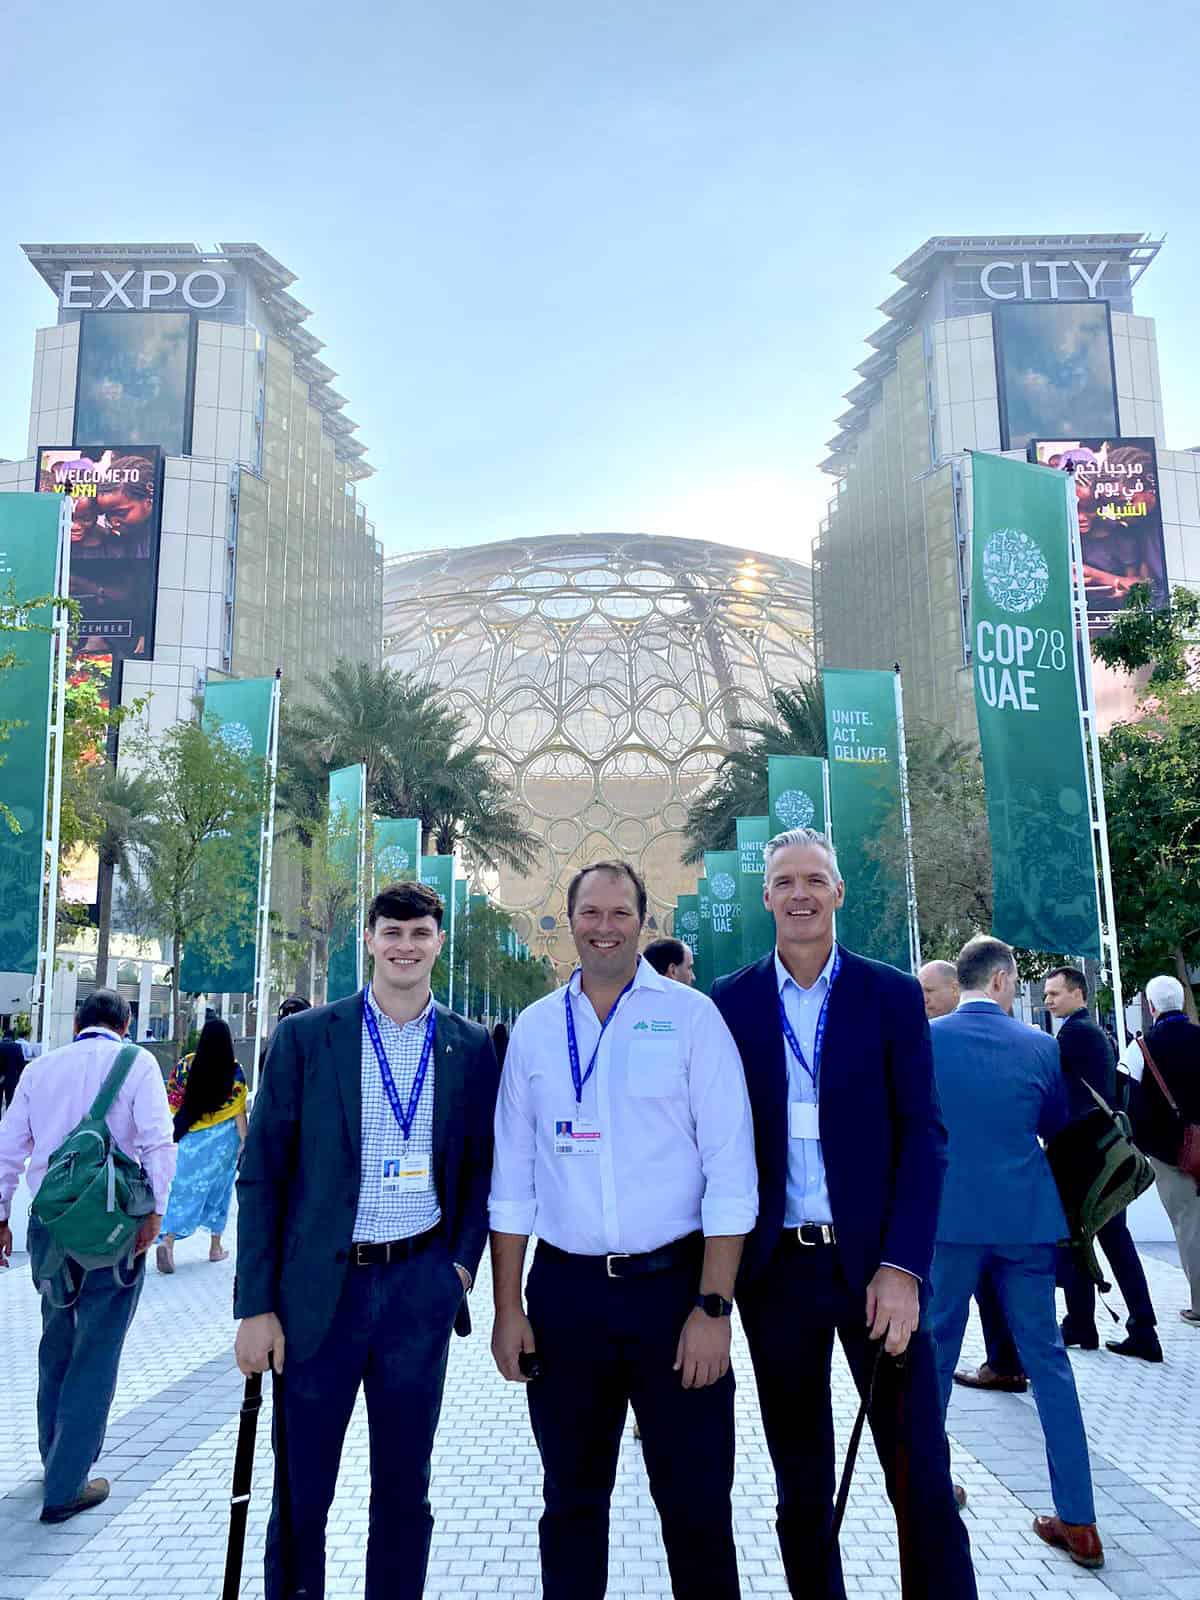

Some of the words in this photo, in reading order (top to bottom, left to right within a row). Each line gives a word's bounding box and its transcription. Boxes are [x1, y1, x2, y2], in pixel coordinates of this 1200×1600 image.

[980, 260, 1109, 299] CITY
[62, 269, 226, 308] EXPO
[55, 469, 121, 483] WELCOME
[122, 469, 140, 482] TO
[1094, 482, 1120, 499] يوم
[1122, 479, 1144, 500] في
[976, 620, 1066, 670] COP28
[979, 666, 1040, 711] UAE
[832, 709, 873, 726] UNITE.
[832, 726, 860, 743] ACT.
[741, 863, 765, 873] DELIV
[713, 918, 733, 932] UAE
